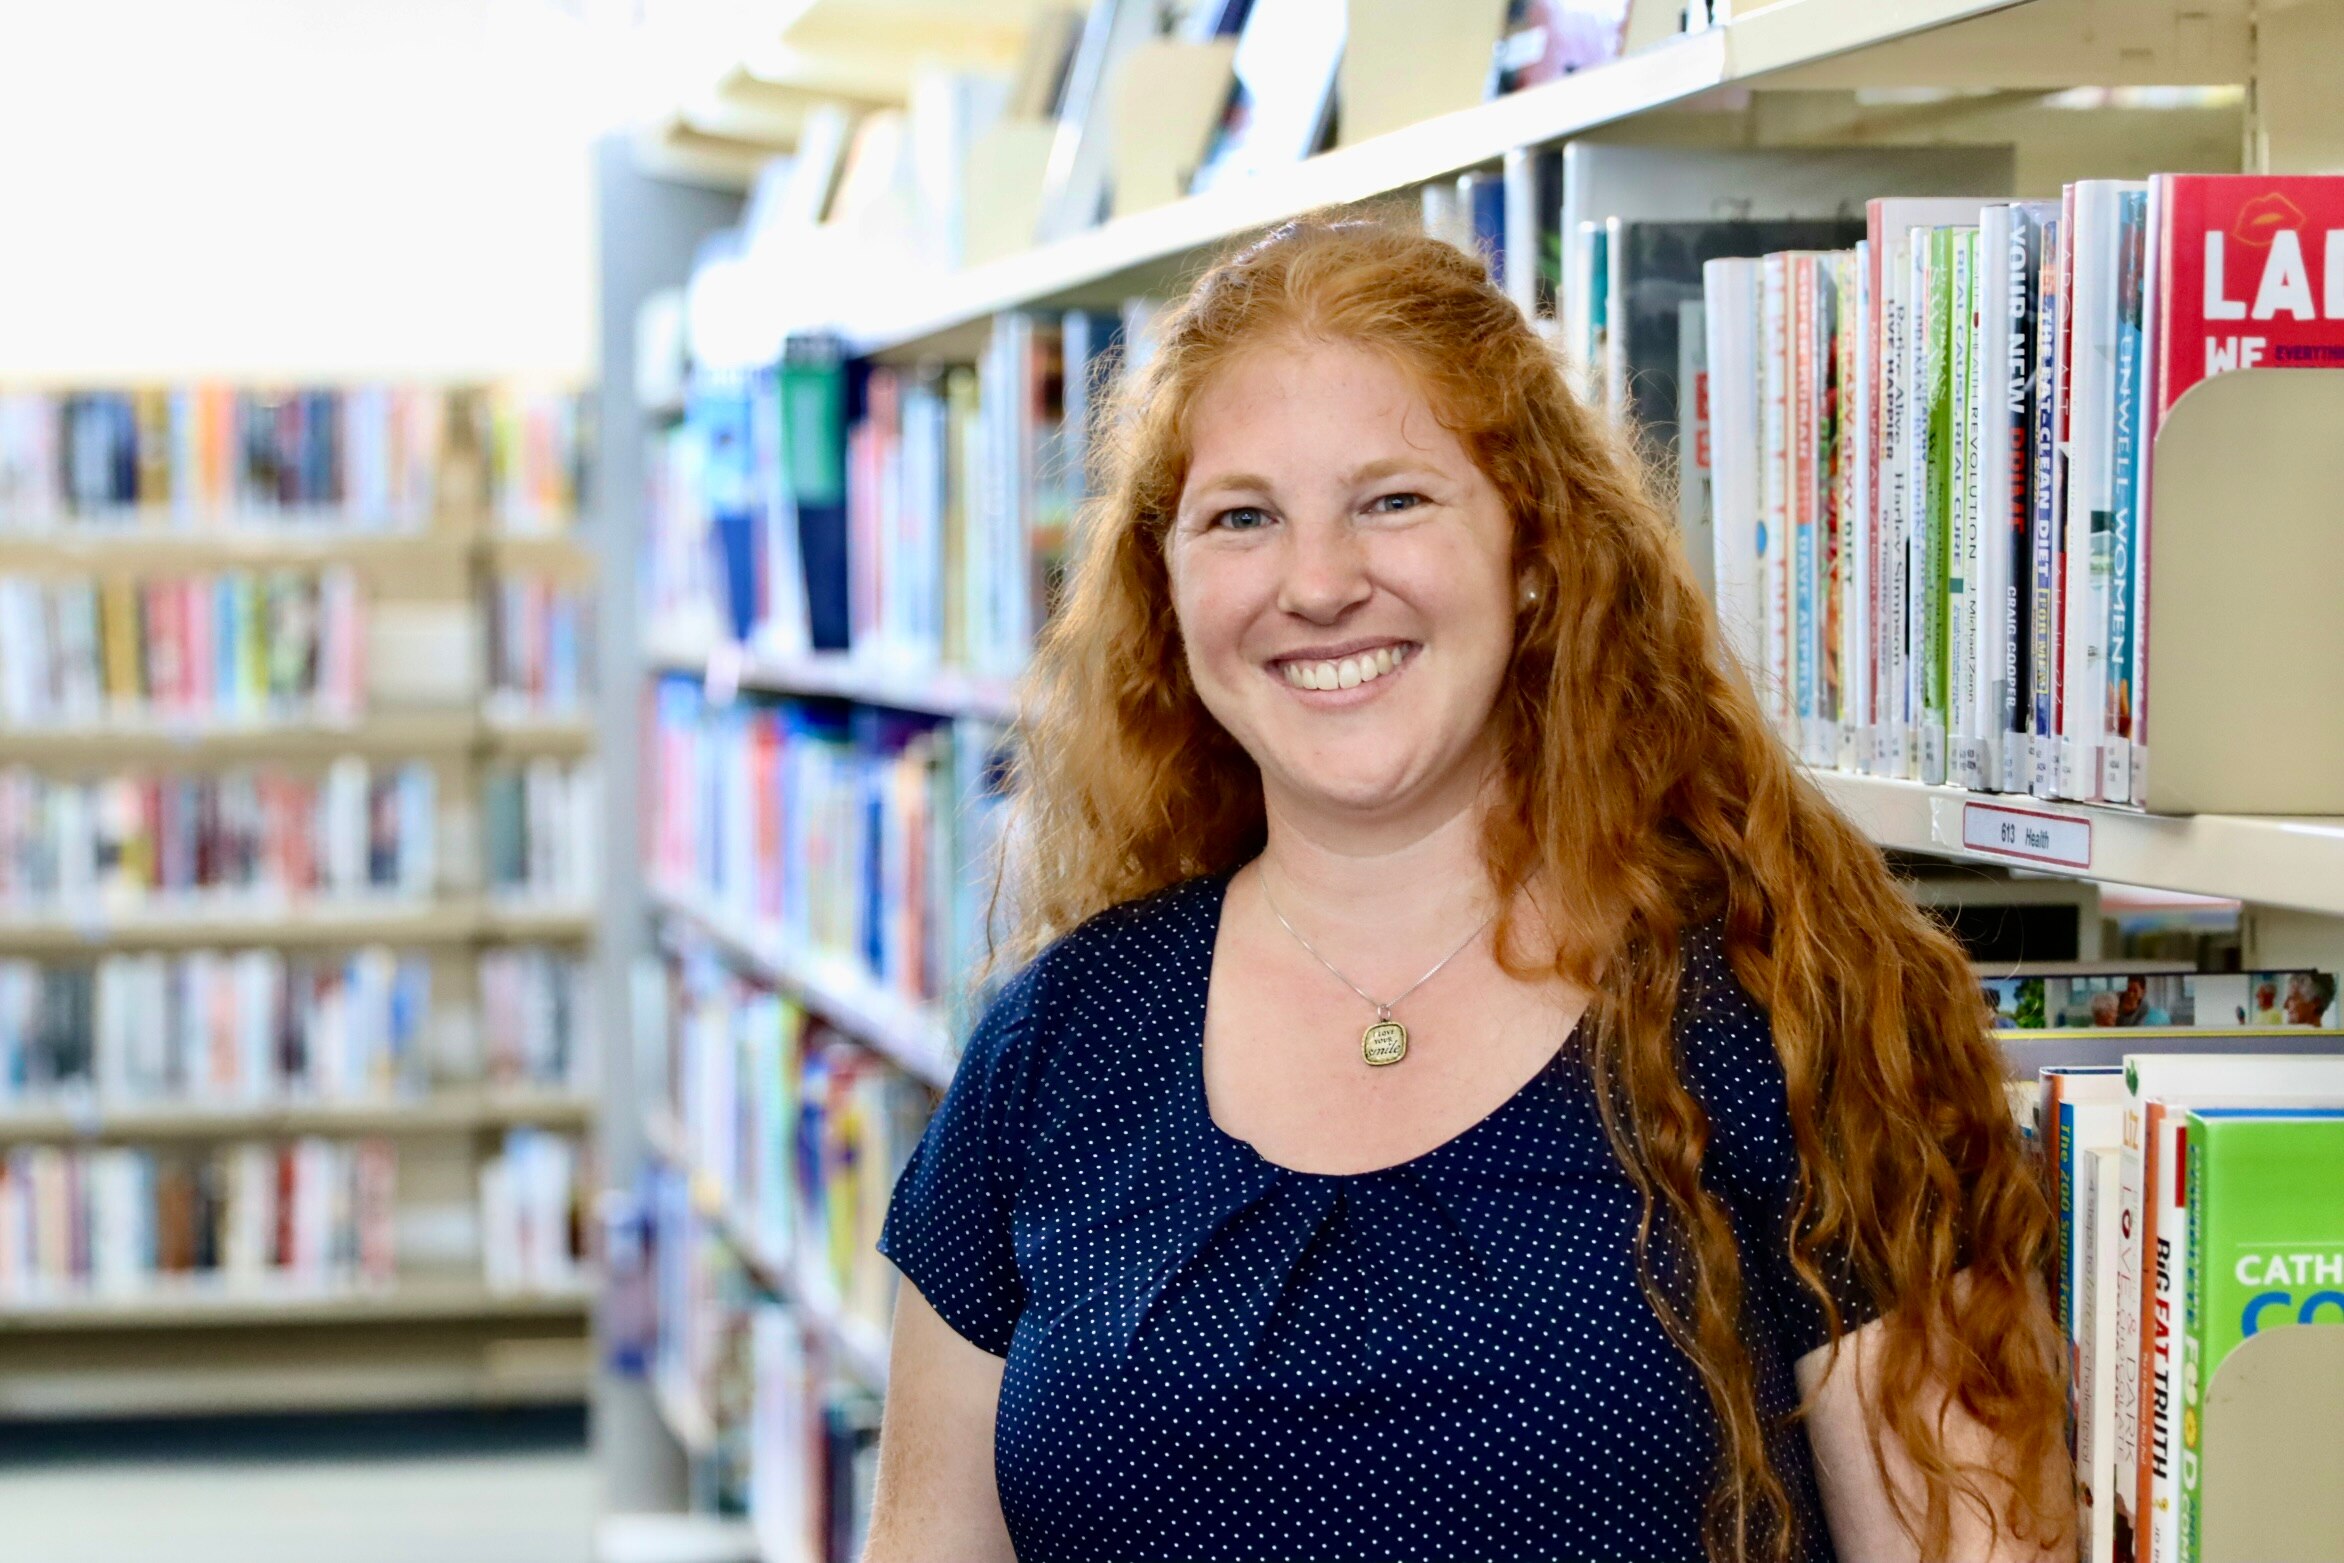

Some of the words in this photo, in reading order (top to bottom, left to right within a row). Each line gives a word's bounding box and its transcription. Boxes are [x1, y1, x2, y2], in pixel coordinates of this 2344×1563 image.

[1956, 249, 1964, 313] REAL
[2007, 225, 2027, 318] YOUR
[2041, 309, 2053, 359] THE
[2007, 333, 2027, 414] NEW
[1886, 359, 1894, 461] HAPPIER
[2039, 367, 2052, 509] EAT-CLEAN
[2115, 336, 2133, 488] UNWELL
[1954, 422, 1962, 489] REAL
[1969, 407, 1978, 559] REVOLUTION
[1894, 472, 1904, 554] Harley
[1953, 497, 1961, 567] CURE
[2038, 519, 2050, 579] DIET
[1892, 561, 1904, 667] Simpson
[2006, 586, 2017, 635] CRAIG
[2111, 508, 2128, 664] WOMEN
[1968, 663, 1976, 703] Zenn
[2005, 642, 2017, 708] COOPER
[2001, 822, 2016, 845] 613
[2025, 827, 2050, 851] Health
[1368, 1040, 1401, 1056] smile
[2060, 1123, 2071, 1163] The
[2060, 1169, 2071, 1213] 200
[2155, 1298, 2170, 1363] FAT
[2082, 1355, 2093, 1465] cholesterol
[2125, 1356, 2136, 1466] DARK
[2152, 1370, 2169, 1479] TRUTH
